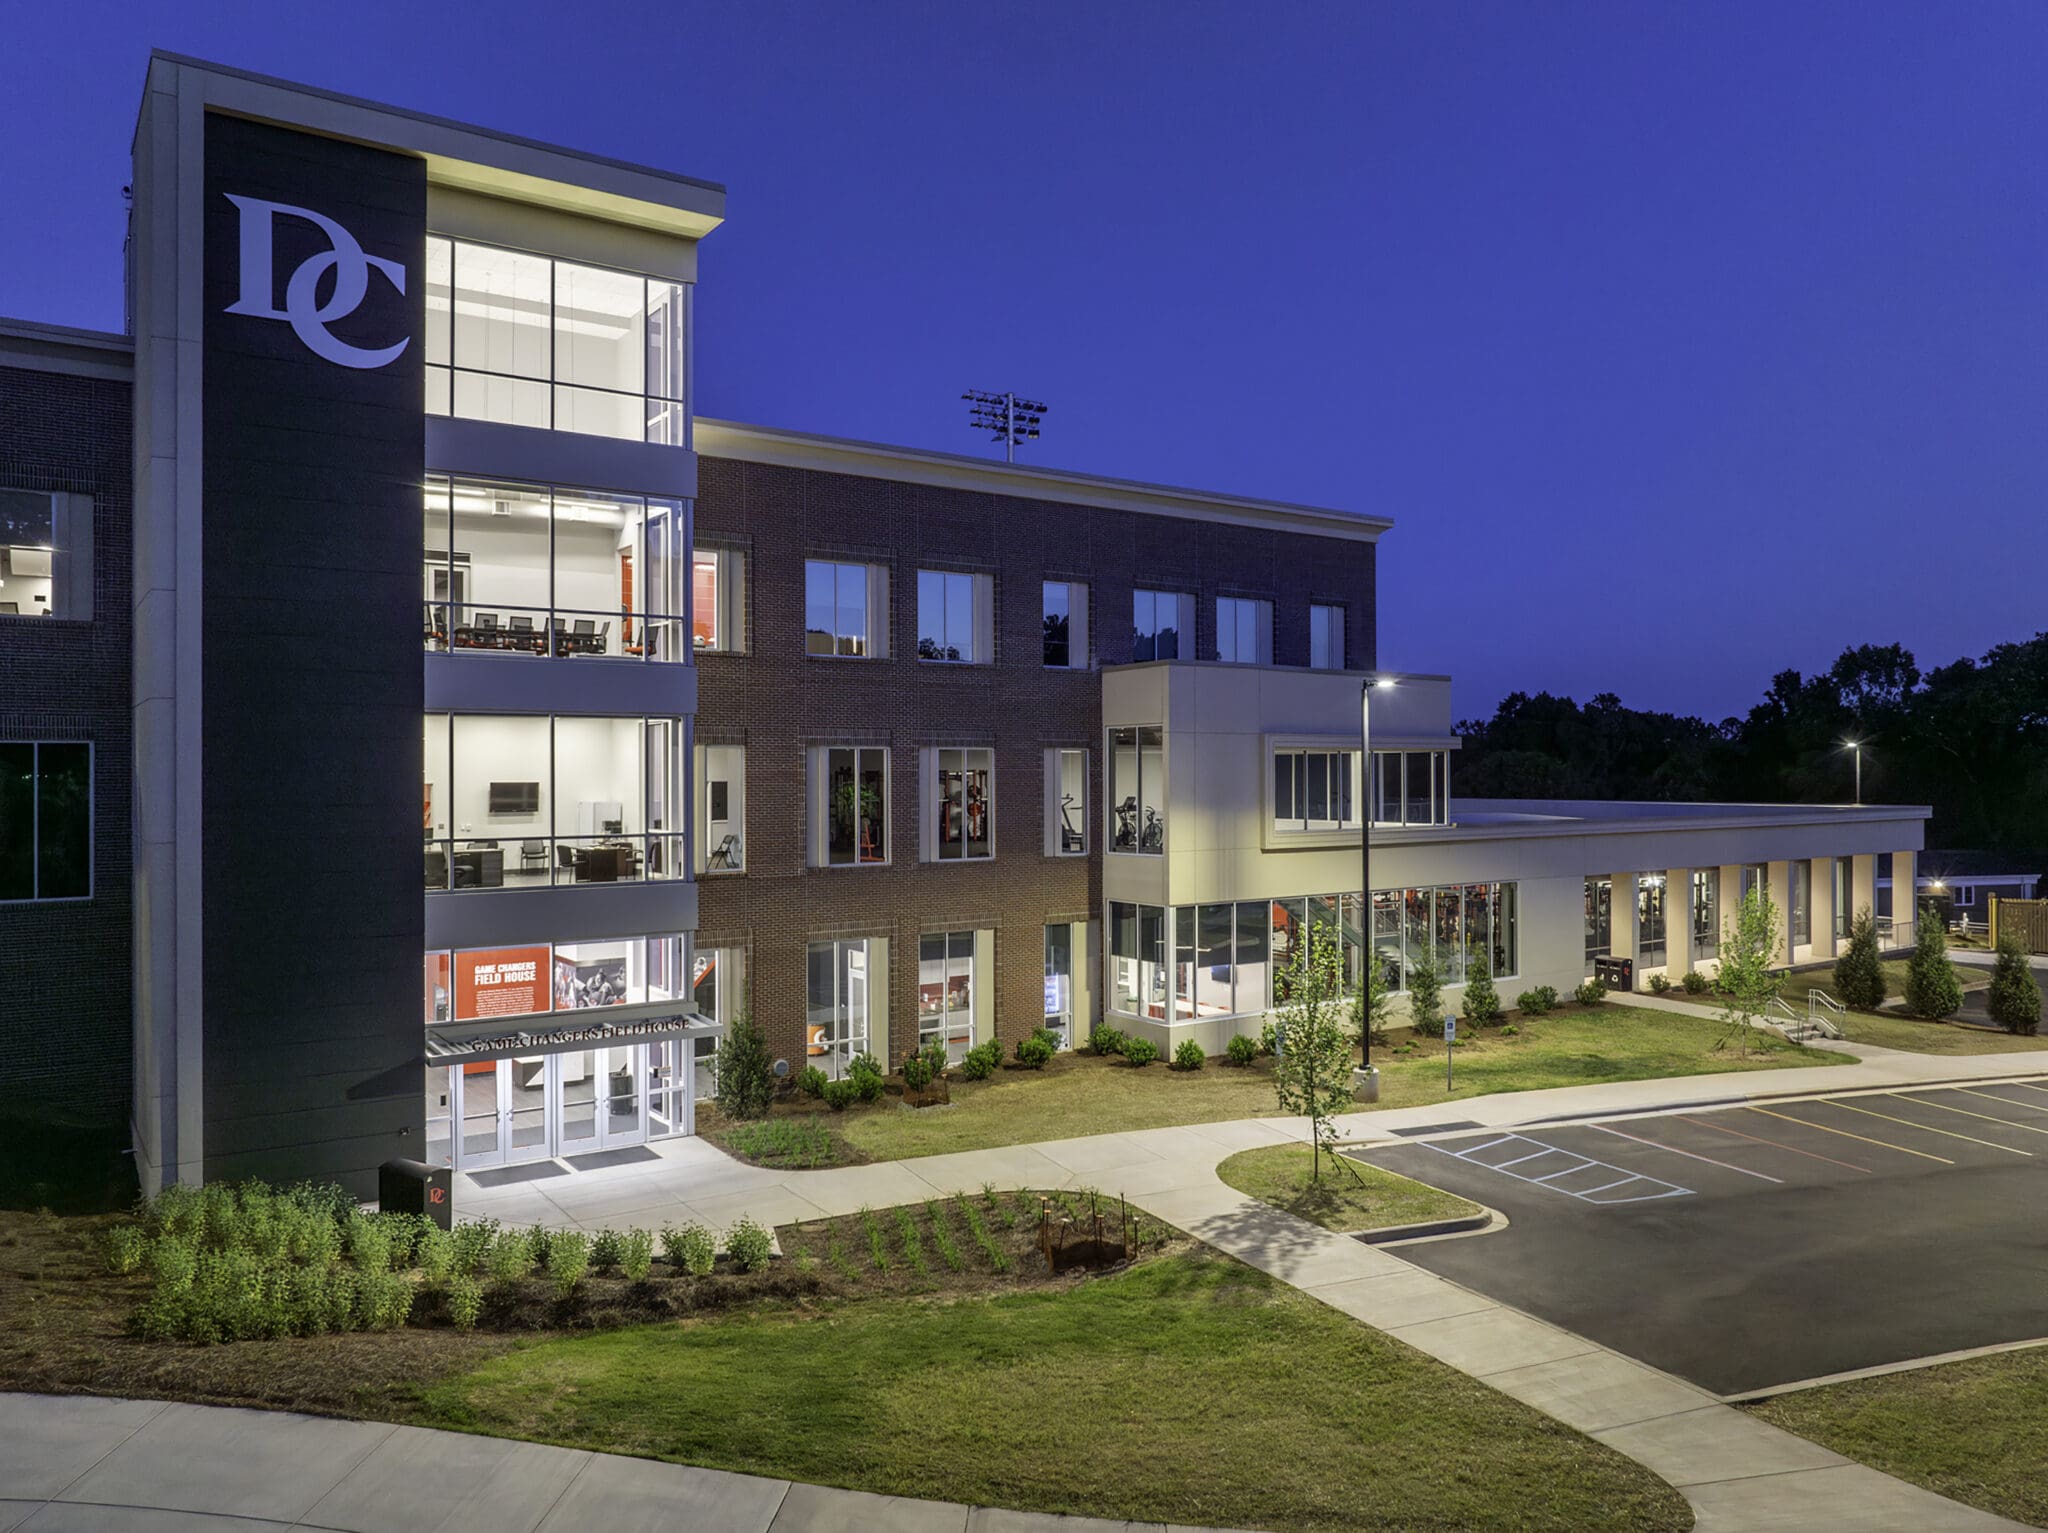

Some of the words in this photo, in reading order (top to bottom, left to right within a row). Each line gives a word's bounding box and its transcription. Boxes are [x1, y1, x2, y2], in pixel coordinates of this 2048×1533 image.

[223, 192, 411, 369] DC
[474, 964, 497, 974] GAME
[497, 961, 536, 973] CHANGERS
[474, 973, 502, 986] FIELD
[504, 970, 537, 983] HOUSE
[472, 1036, 516, 1051] GAME
[519, 1028, 599, 1048] CHANGERS
[602, 1024, 642, 1038] FIELD
[644, 1019, 690, 1034] HOUSE
